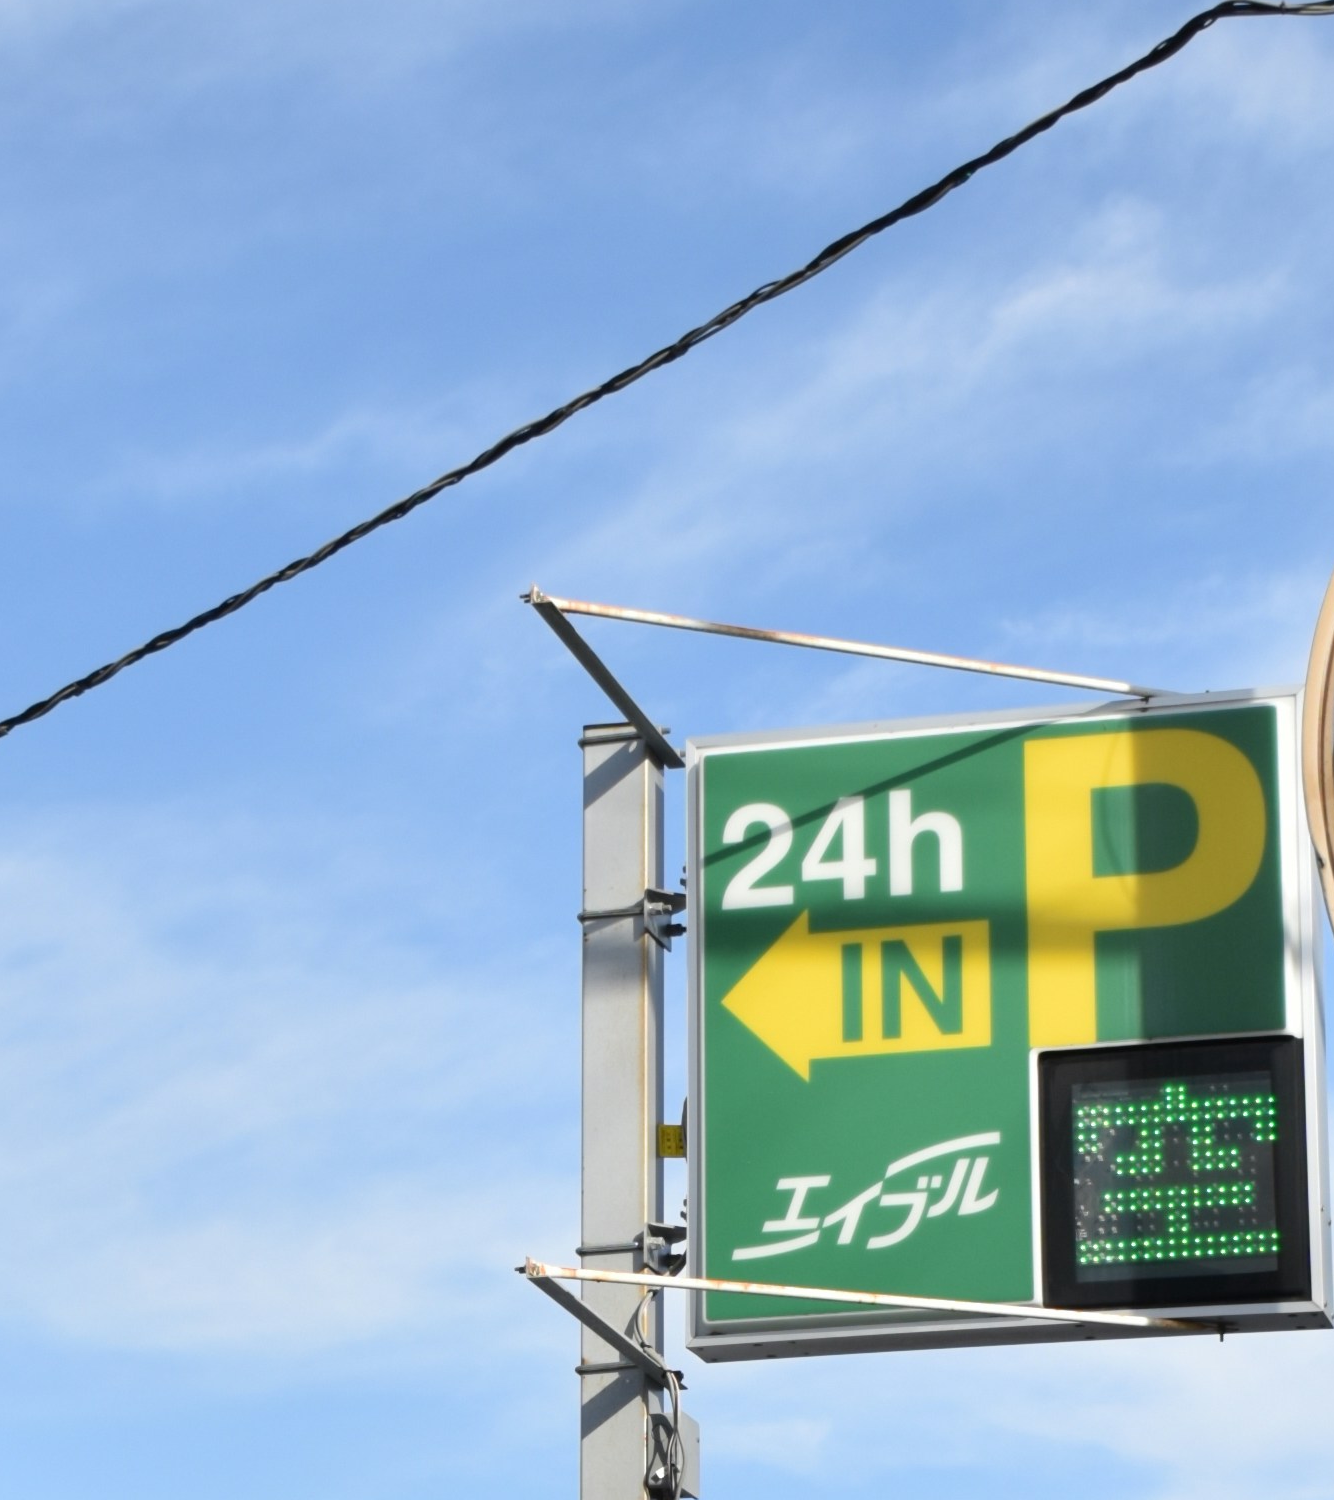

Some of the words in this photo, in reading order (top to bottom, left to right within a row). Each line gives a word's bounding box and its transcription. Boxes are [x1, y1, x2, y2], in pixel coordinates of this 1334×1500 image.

[722, 790, 963, 912] 24h
[1024, 728, 1267, 1047] P
[843, 936, 962, 1042] IN
[733, 1132, 1000, 1260] エイブル
[1076, 1083, 1280, 1264] 空
